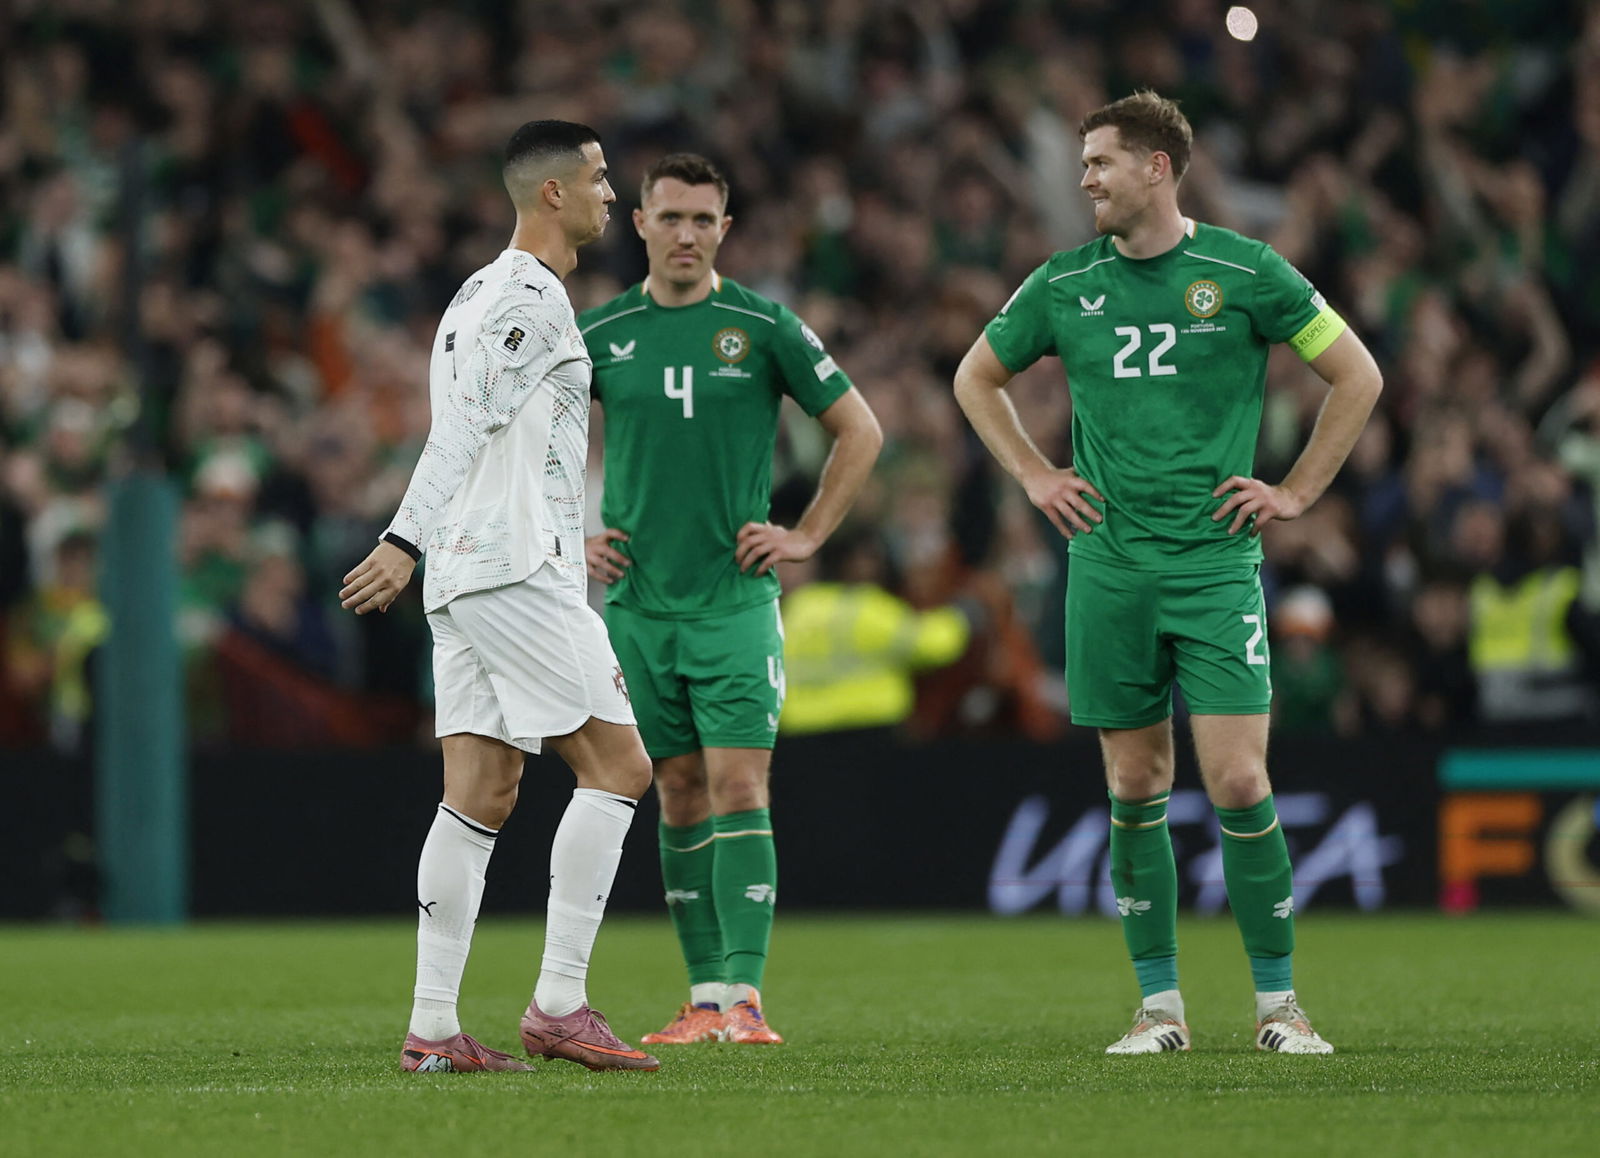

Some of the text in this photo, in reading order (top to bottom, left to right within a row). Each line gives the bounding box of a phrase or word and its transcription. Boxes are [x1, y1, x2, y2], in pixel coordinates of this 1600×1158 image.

[1113, 323, 1178, 379] 22
[1298, 318, 1328, 348] RESPECT
[664, 366, 694, 419] 4
[988, 793, 1402, 918] UFA
